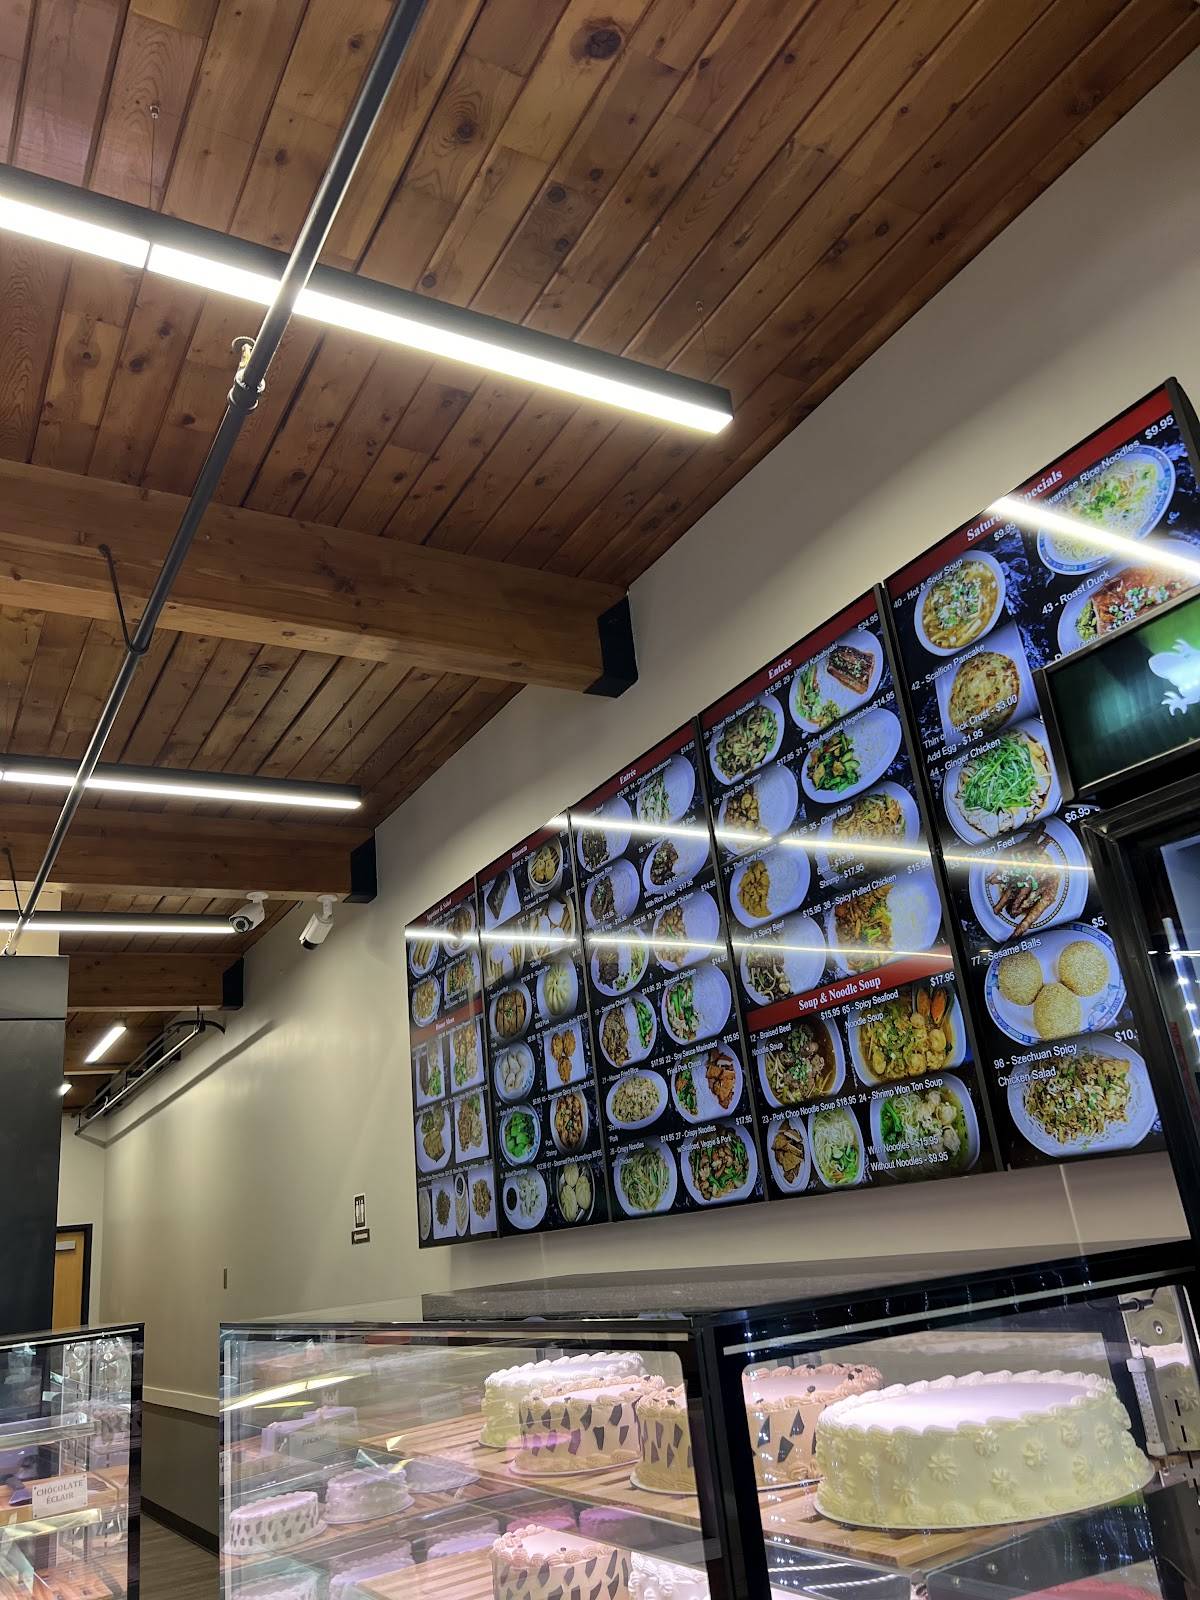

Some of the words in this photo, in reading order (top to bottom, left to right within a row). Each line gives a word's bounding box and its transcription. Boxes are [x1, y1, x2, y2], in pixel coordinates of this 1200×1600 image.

[1145, 415, 1174, 439] $9.95
[1079, 466, 1099, 484] Rice
[1101, 440, 1140, 469] Noodles
[1022, 470, 1063, 503] pecials
[993, 520, 1017, 541] $9.95
[893, 598, 903, 609] 40
[906, 588, 920, 601] Hot
[926, 571, 943, 586] Sour
[943, 559, 963, 575] Soup
[1042, 603, 1054, 615] 43
[1059, 584, 1086, 605] Roast
[1086, 570, 1111, 589] Duck
[857, 613, 879, 633] $24.95
[911, 682, 921, 691] 42
[925, 662, 953, 684] Scallion
[952, 644, 986, 667] Pancake
[872, 691, 896, 710] $14.95
[922, 736, 942, 750] Thin
[969, 710, 990, 726] Crust
[995, 694, 1018, 713] $3.00
[776, 751, 795, 767] $17.95
[796, 746, 803, 757] 31
[806, 736, 819, 749] Tofu
[926, 751, 941, 765] Add
[941, 743, 957, 758] Egg
[962, 728, 984, 747] $1.95
[929, 768, 940, 778] 44
[944, 753, 969, 772] Ginger
[969, 738, 1001, 758] Chicken
[744, 773, 761, 788] Shrimp
[820, 813, 837, 825] Chow
[837, 805, 853, 817] Mein
[1064, 807, 1091, 825] $6.95
[996, 836, 1017, 851] Feet
[820, 875, 840, 889] Shrimp
[843, 863, 865, 879] $17.95
[802, 903, 821, 919] $15.95
[823, 901, 832, 911] 38
[834, 892, 852, 906] Spicy
[851, 883, 871, 899] Pulled
[871, 874, 897, 890] Chicken
[772, 920, 785, 932] Beef
[970, 955, 982, 967] 77
[987, 944, 1020, 962] Sesame
[1020, 938, 1042, 951] Balls
[930, 971, 955, 987] $17.95
[798, 996, 818, 1011] Soup
[819, 992, 828, 1003] &
[828, 983, 858, 1001] Noodle
[858, 976, 881, 992] Soup
[820, 1008, 841, 1021] $15.95
[842, 1004, 850, 1015] 65
[855, 999, 872, 1012] Spicy
[872, 989, 899, 1005] Seafood
[749, 1034, 756, 1042] 12
[760, 1027, 779, 1040] Braised
[779, 1023, 792, 1034] Beef
[844, 1017, 867, 1031] Noodle
[867, 1012, 884, 1024] Soup
[723, 1031, 740, 1044] $15.95
[751, 1047, 770, 1057] Noodle
[770, 1042, 783, 1053] Soup
[993, 1058, 1005, 1070] 98
[1010, 1050, 1053, 1067] Szechuan
[1053, 1043, 1078, 1058] Spicy
[997, 1072, 1031, 1088] Chicken
[1030, 1066, 1057, 1080] Salad
[858, 1094, 867, 1104] 24
[871, 1089, 895, 1102] Shrimp
[894, 1085, 911, 1096] Won
[911, 1081, 924, 1092] Ton
[924, 1078, 943, 1090] Soup
[735, 1114, 753, 1127] $17.95
[761, 1115, 769, 1124] 23
[772, 1111, 785, 1122] Pork
[785, 1108, 800, 1119] Chop
[799, 1105, 820, 1116] Noodle
[820, 1101, 836, 1112] Soup
[836, 1095, 857, 1108] $18.95
[698, 1123, 716, 1136] Noodles
[867, 1144, 882, 1155] With
[883, 1140, 910, 1153] Noodles
[914, 1135, 939, 1148] $15.95
[870, 1159, 895, 1172] Without
[895, 1156, 923, 1169] Noodles
[928, 1151, 949, 1164] $9.95
[36, 1480, 84, 1496] CHOCOLATE
